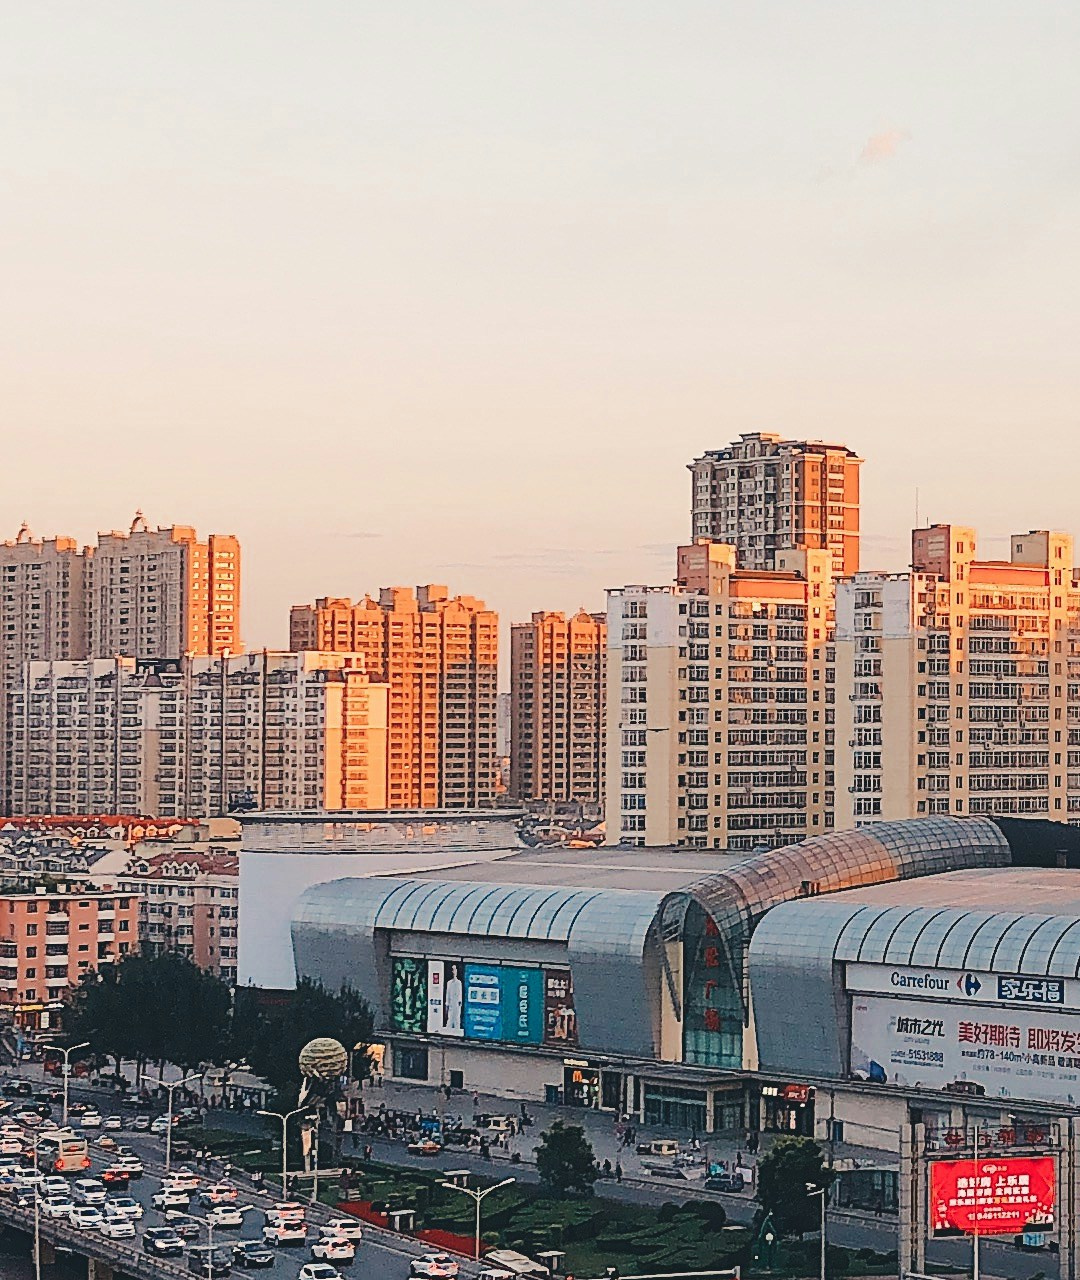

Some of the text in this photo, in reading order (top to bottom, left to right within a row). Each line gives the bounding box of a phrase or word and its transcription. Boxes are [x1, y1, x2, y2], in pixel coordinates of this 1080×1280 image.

[891, 971, 950, 991] Carrefour
[1001, 978, 1060, 1003] 家乐福
[897, 1016, 945, 1037] 城市之光
[958, 1021, 1021, 1049] 美好期待
